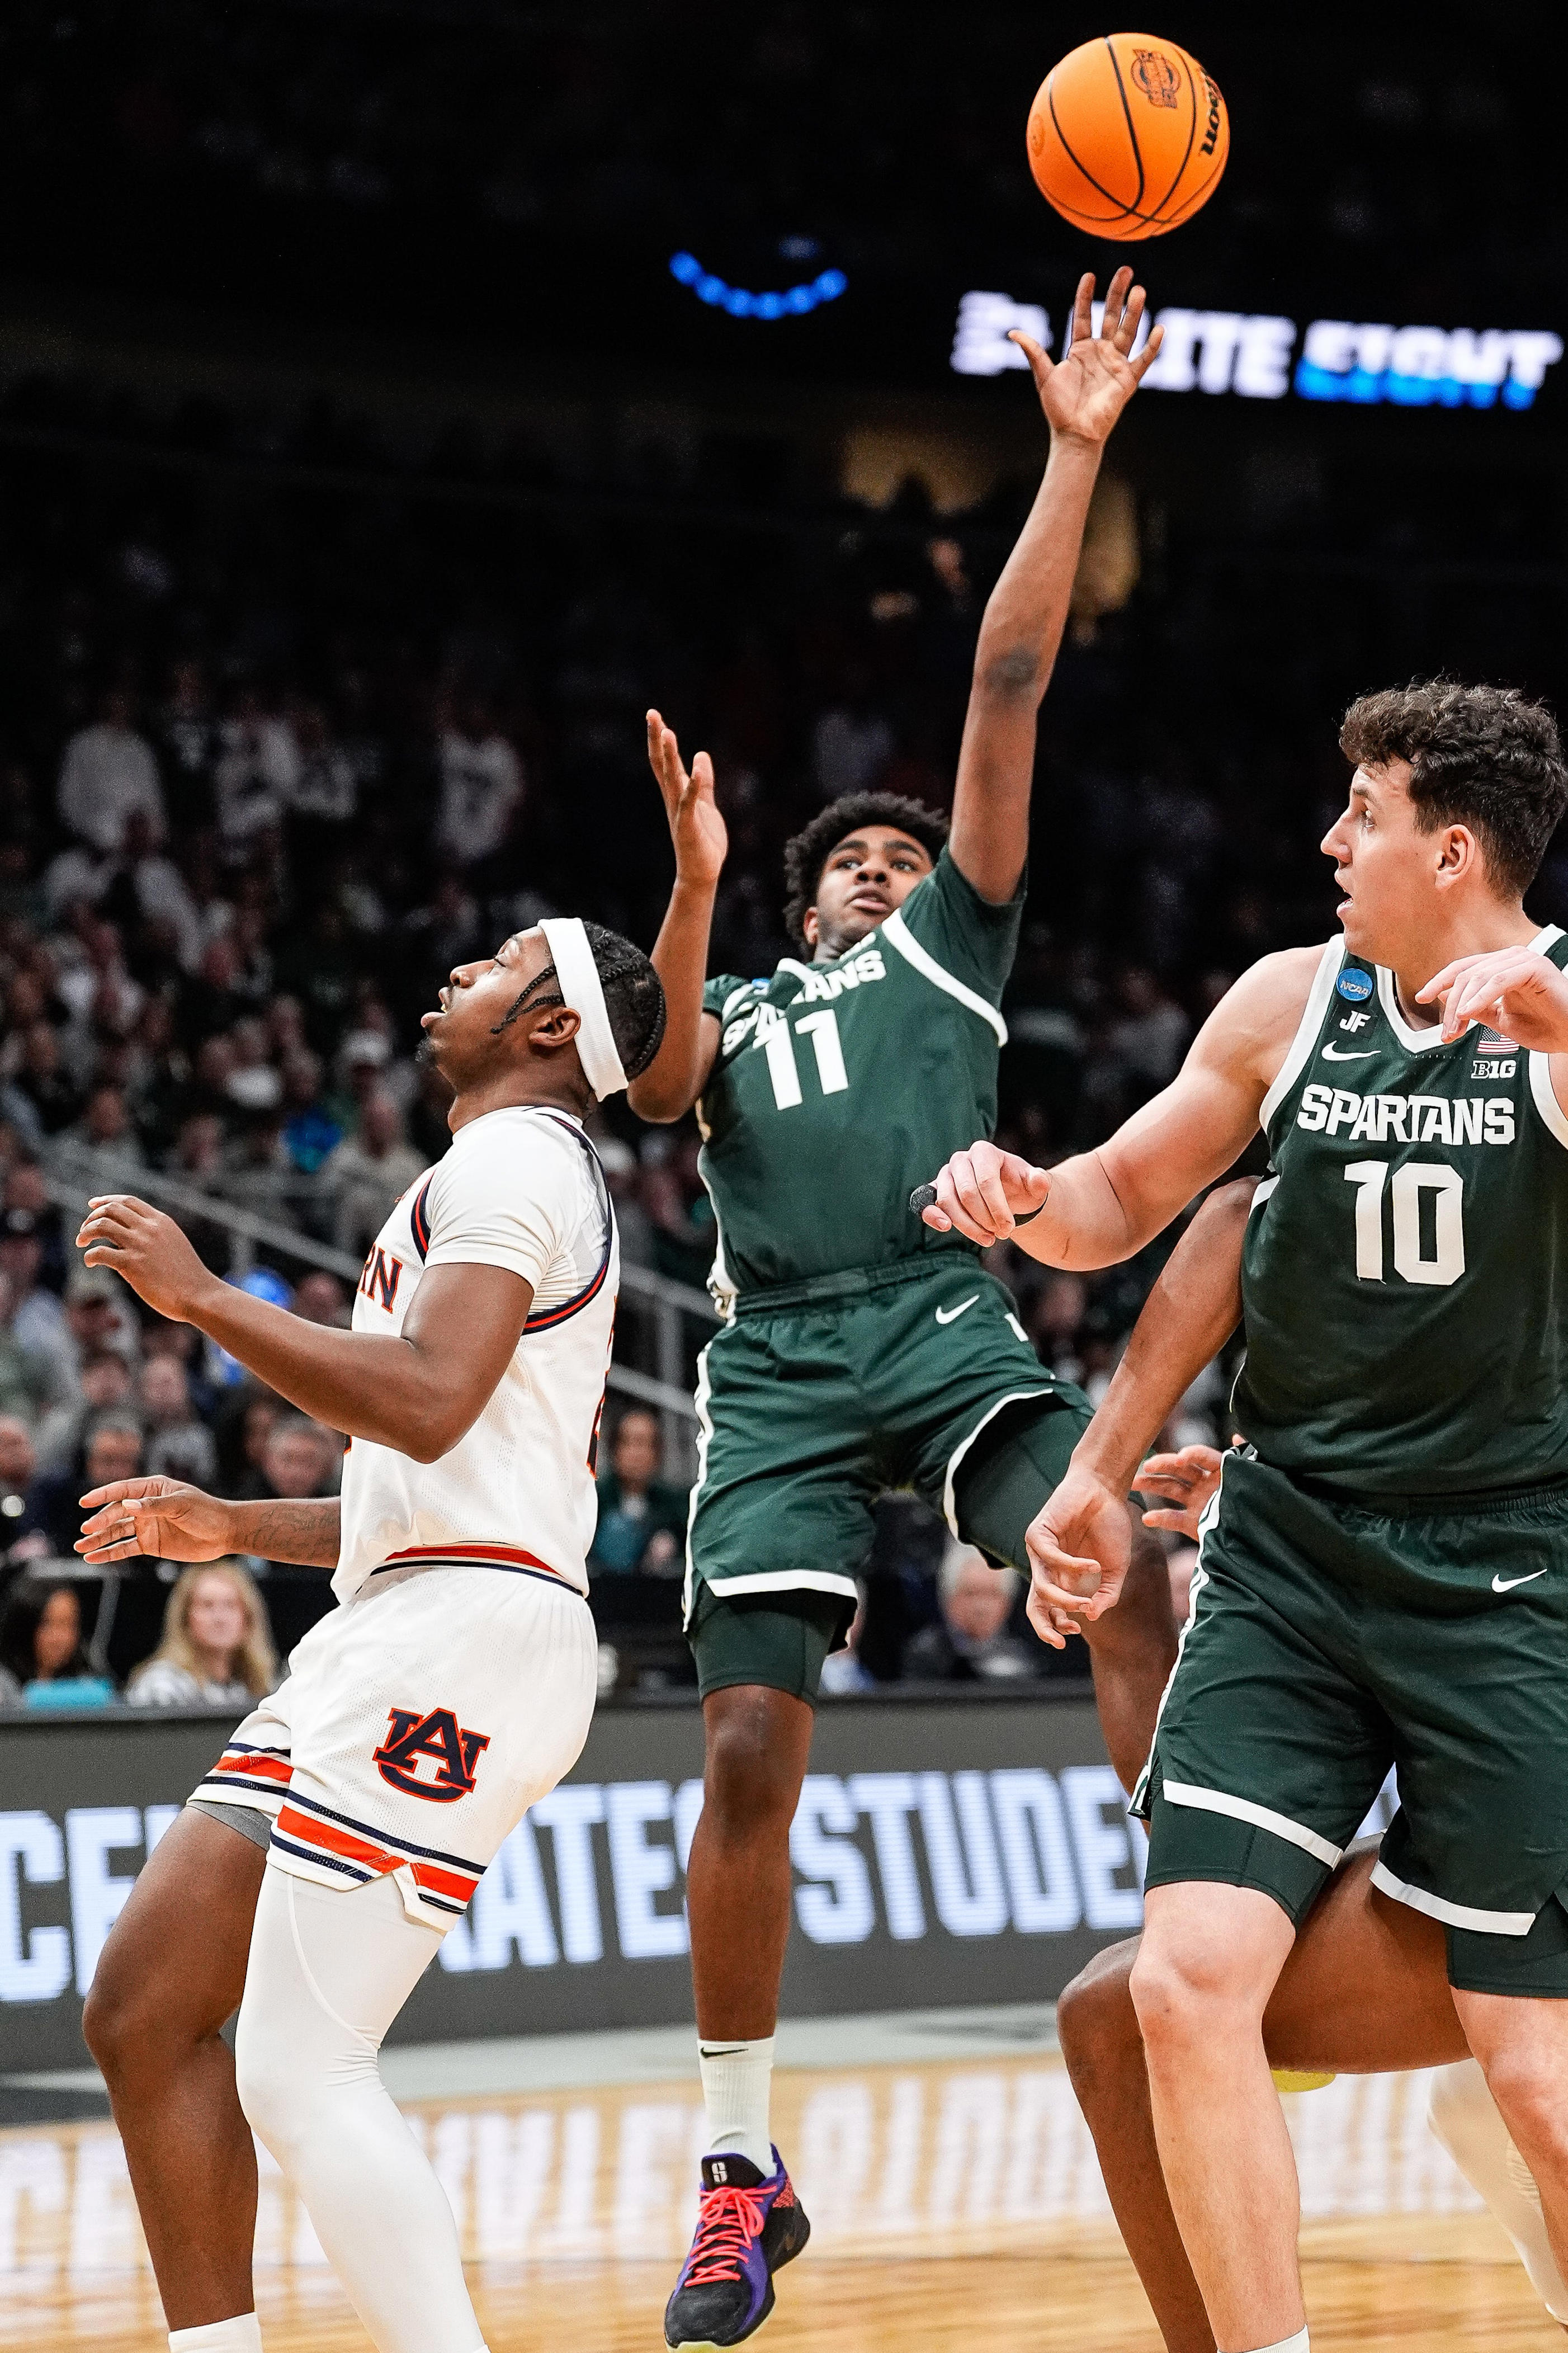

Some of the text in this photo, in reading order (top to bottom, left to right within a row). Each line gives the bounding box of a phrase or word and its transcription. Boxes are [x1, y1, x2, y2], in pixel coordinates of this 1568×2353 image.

[1339, 1010, 1371, 1033] JF
[1340, 980, 1369, 997] NCAA
[753, 1008, 848, 1111] 11
[1297, 1084, 1515, 1145] SPARTANS
[1344, 1160, 1466, 1286] 10
[787, 1763, 1149, 1945] STUDE
